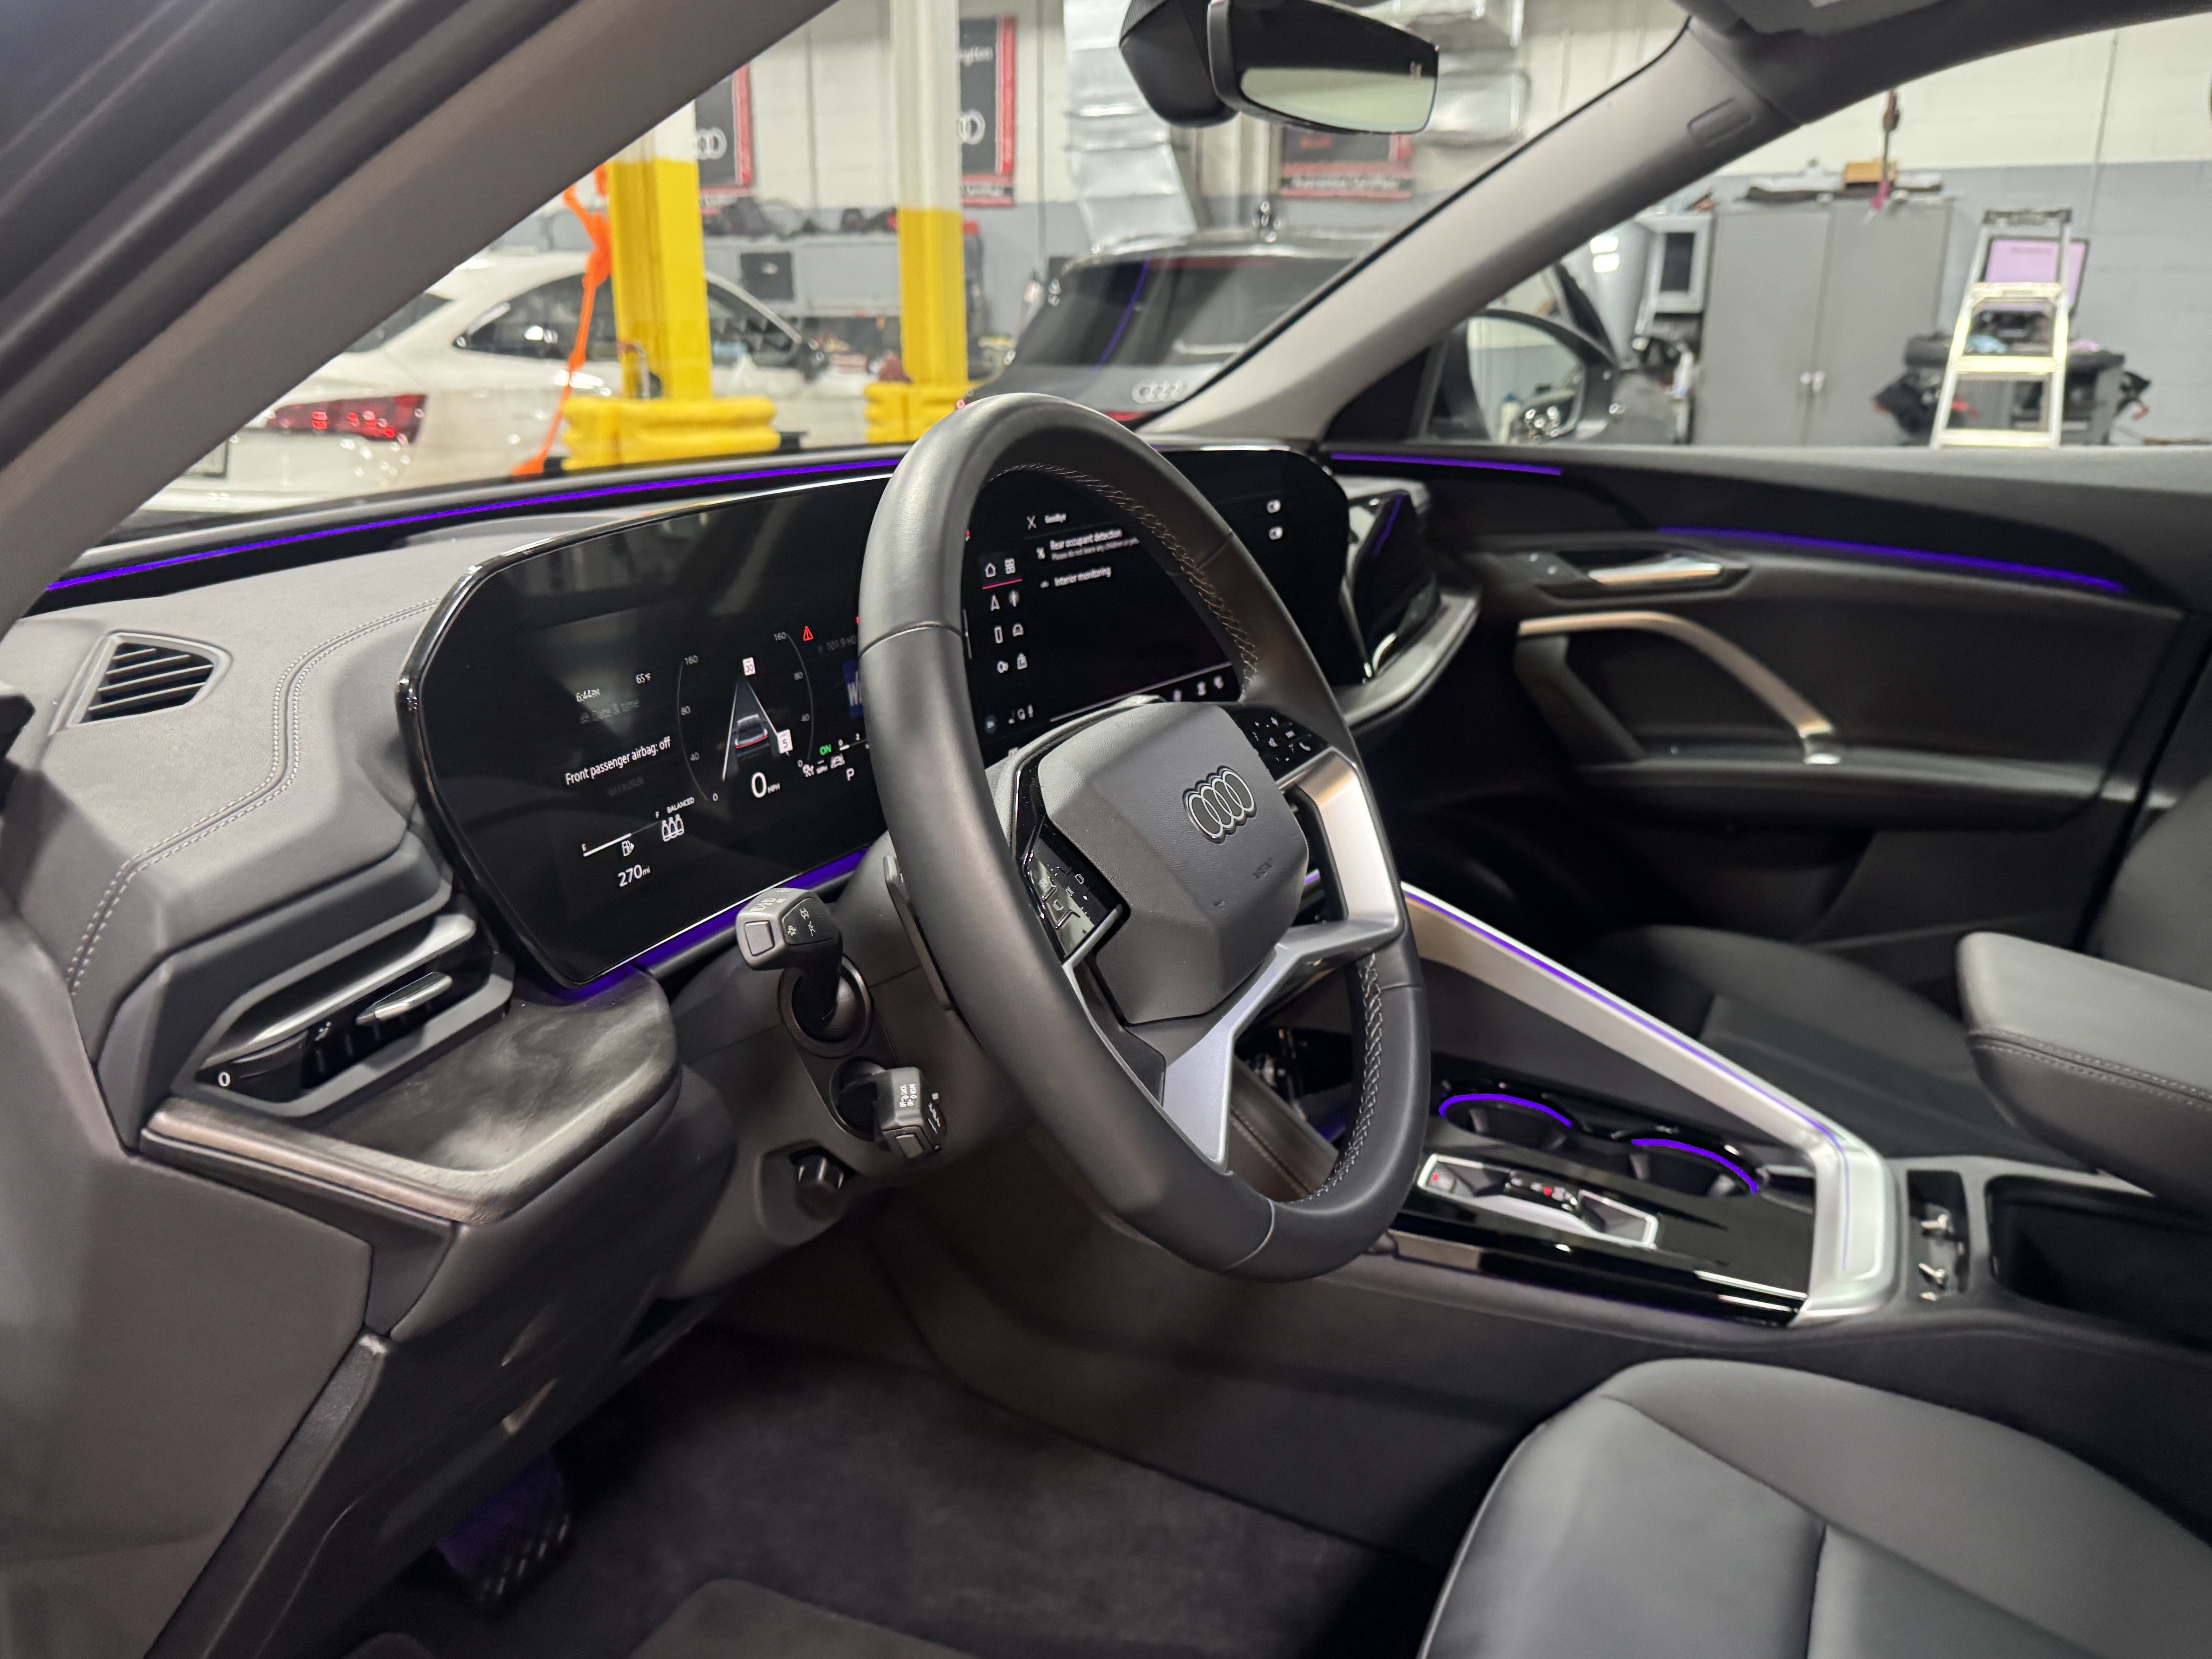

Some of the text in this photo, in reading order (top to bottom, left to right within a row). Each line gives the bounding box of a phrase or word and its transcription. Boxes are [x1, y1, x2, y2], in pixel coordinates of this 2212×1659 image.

[782, 738, 788, 749] 5
[820, 744, 831, 755] ON
[565, 736, 671, 785] Front passenger airbag: off
[846, 768, 855, 781] P
[751, 772, 767, 798] 0
[667, 797, 694, 813] BALANCED
